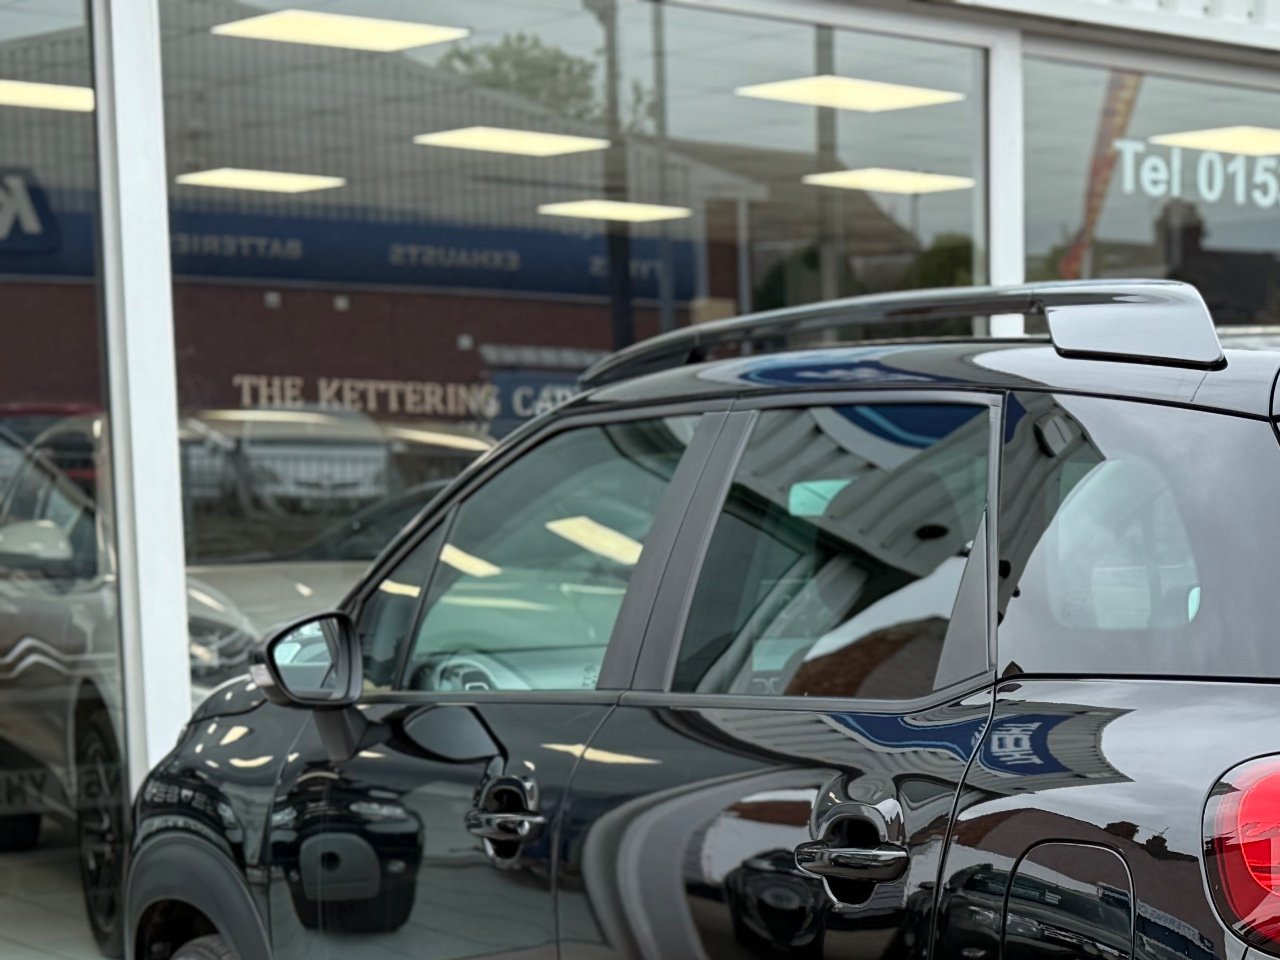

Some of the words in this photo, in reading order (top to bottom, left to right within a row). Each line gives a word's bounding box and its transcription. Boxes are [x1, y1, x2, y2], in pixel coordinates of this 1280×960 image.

[1114, 139, 1182, 198] Tel
[232, 374, 304, 408] THE
[317, 377, 499, 418] KETTERING
